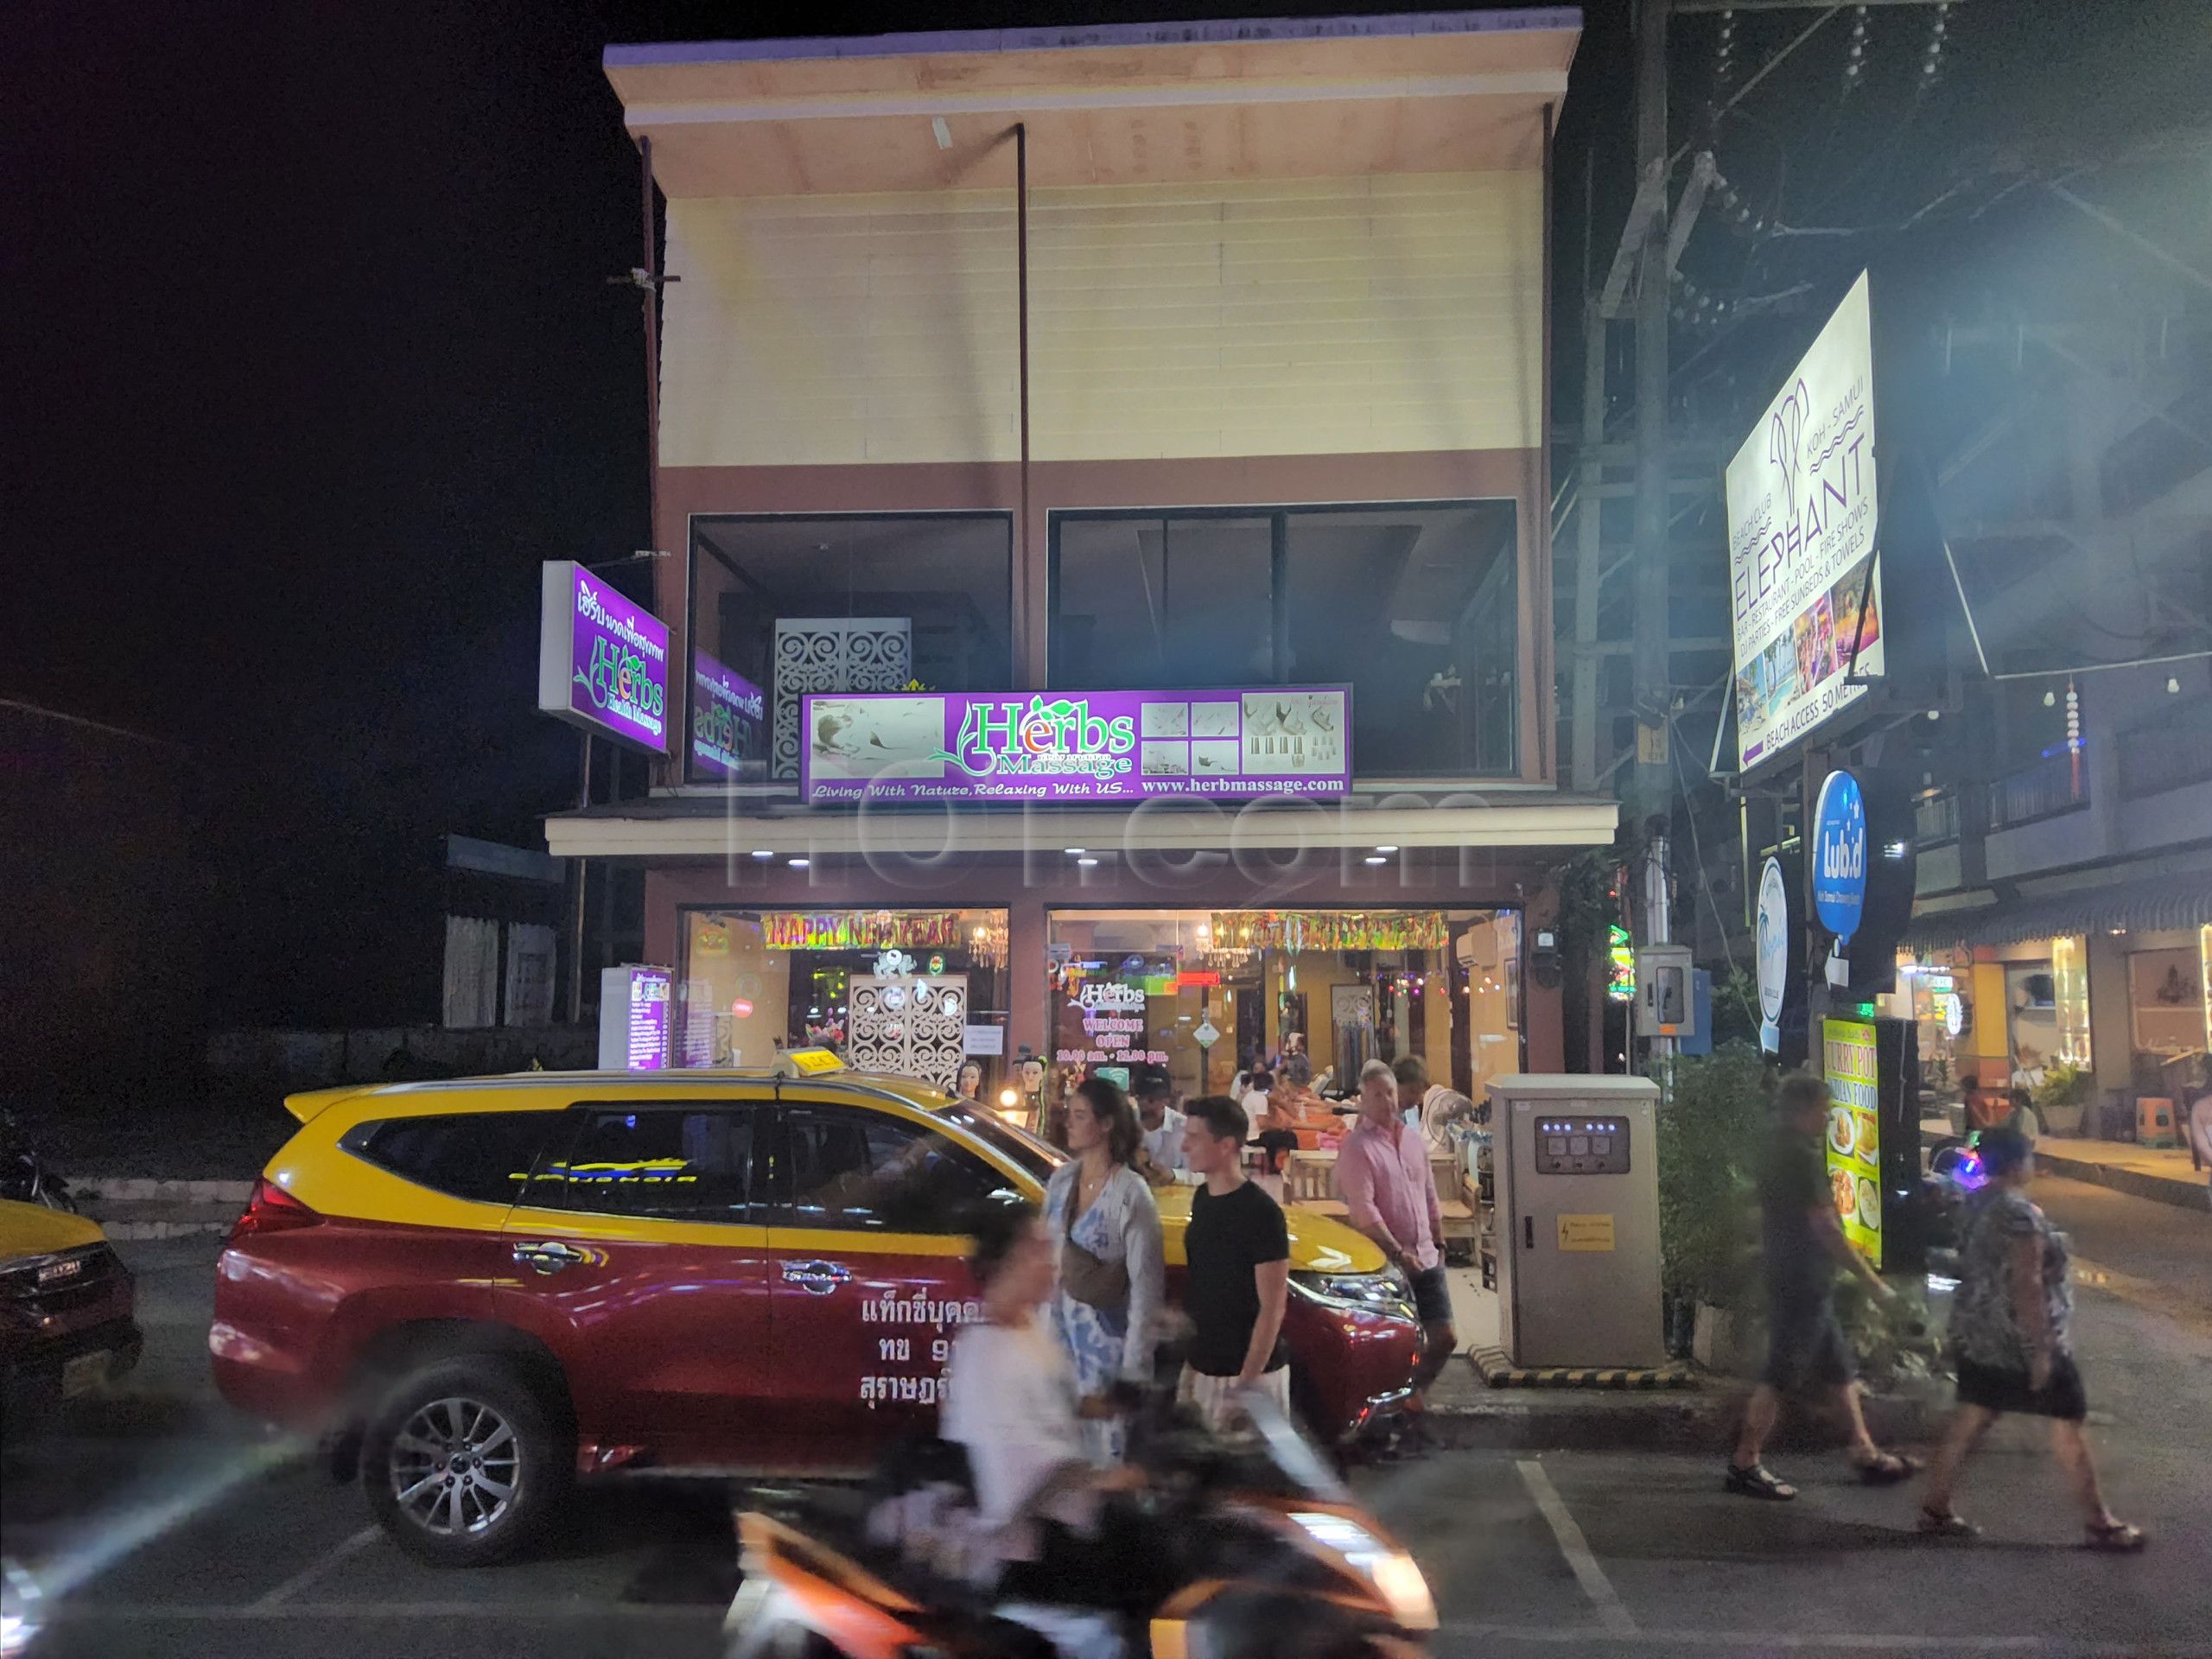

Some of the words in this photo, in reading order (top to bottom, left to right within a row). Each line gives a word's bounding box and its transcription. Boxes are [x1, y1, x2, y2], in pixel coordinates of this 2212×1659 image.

[1808, 422, 1826, 458] KOH
[1833, 376, 1863, 428] SAMUI
[1732, 516, 1753, 550] BEACH
[1754, 493, 1771, 520] CLUB
[1735, 432, 1865, 622] ELEPHANT
[1752, 577, 1790, 628] RESTAURANT
[1795, 554, 1815, 585] POOL
[1820, 531, 1835, 561] FIRE
[1837, 496, 1868, 542] SHOWS
[1749, 619, 1770, 650] PARTIES
[1775, 599, 1790, 626] FREE
[1791, 566, 1823, 610] SUNBEDS
[1832, 524, 1865, 569] TOWELS
[596, 634, 664, 716] Herbs
[972, 698, 1135, 754] Herbs
[1766, 721, 1789, 750] BEACH
[1790, 699, 1819, 732] ACCESS
[1822, 690, 1833, 712] 50
[996, 753, 1133, 779] Massage
[812, 785, 862, 799] Living
[868, 784, 906, 796] With
[1052, 782, 1090, 795] With
[1141, 778, 1344, 794] www.herbmassage.com
[772, 914, 843, 946] HAPPY
[1085, 982, 1146, 1003] Herbs
[1083, 1018, 1144, 1032] WELCOME
[1095, 1034, 1130, 1047] OPEN
[1826, 1040, 1854, 1075] CURRY
[1857, 1045, 1876, 1078] POT
[1853, 1083, 1876, 1109] FOOD
